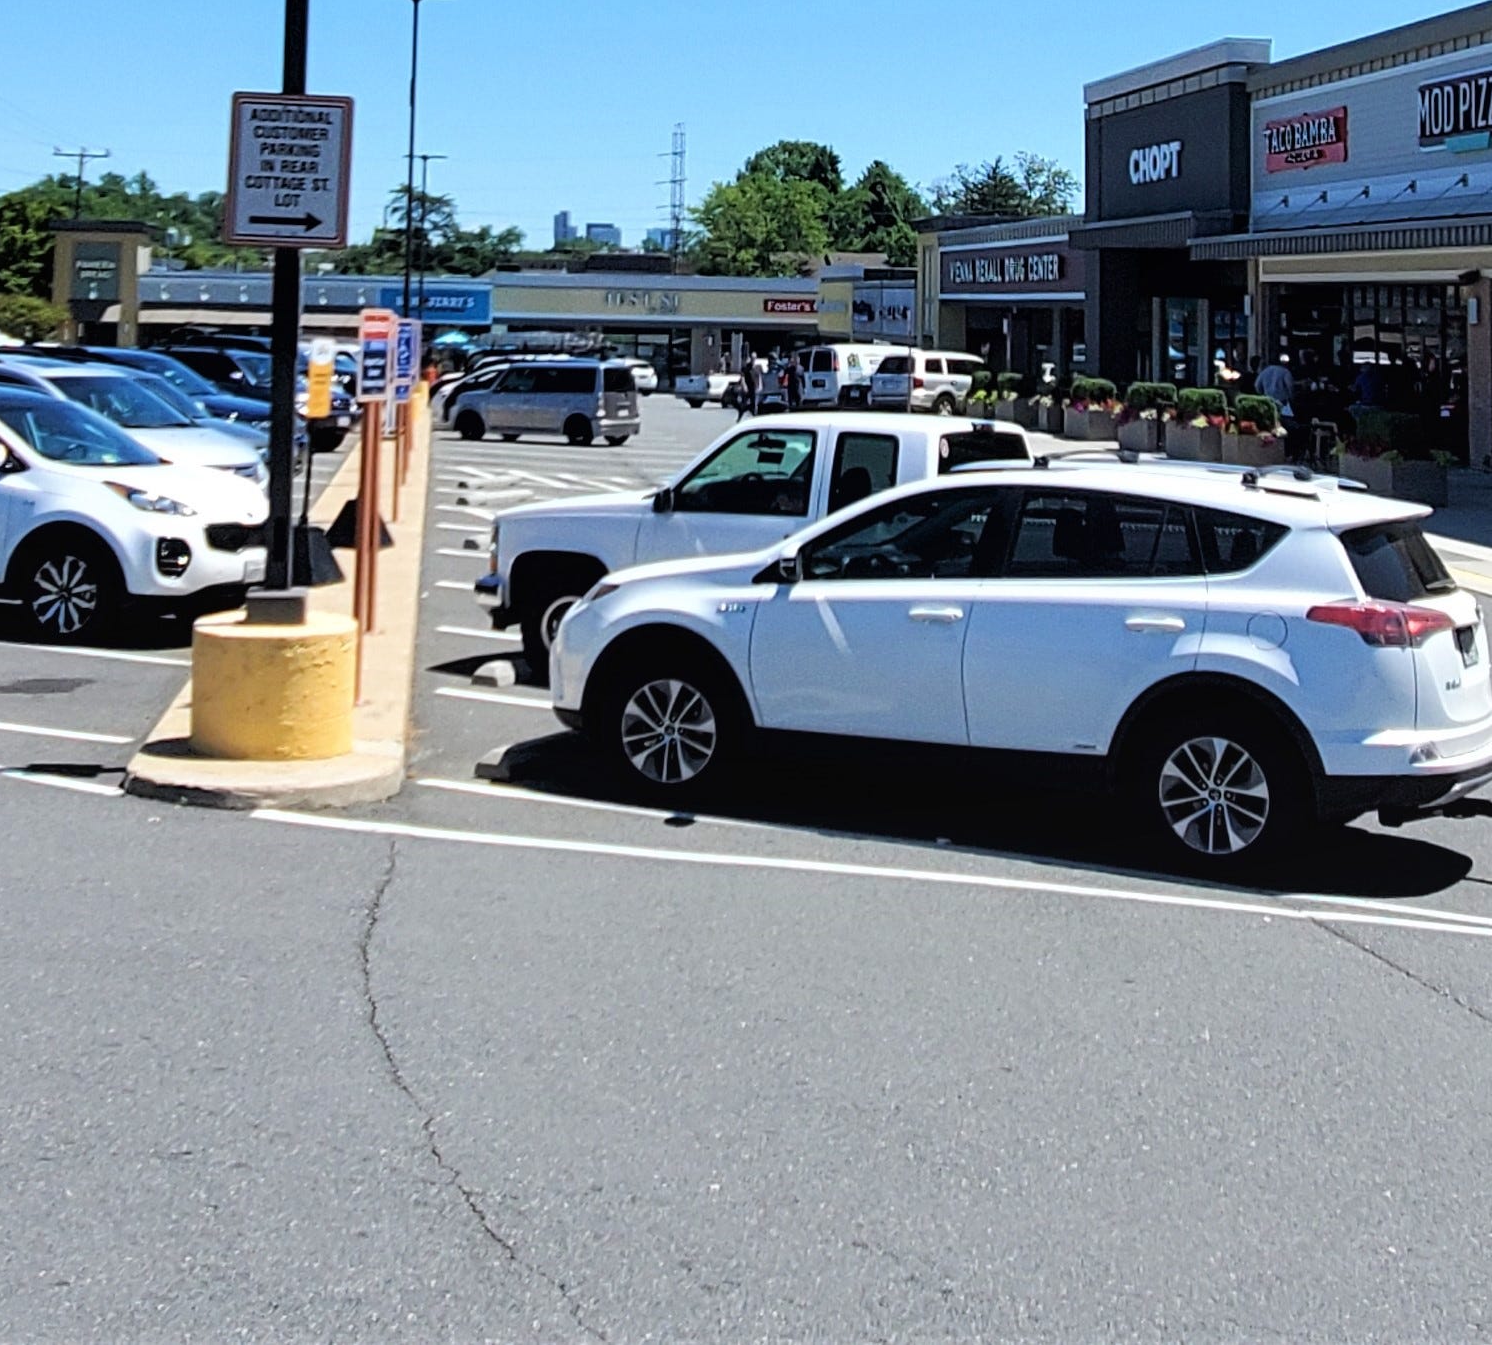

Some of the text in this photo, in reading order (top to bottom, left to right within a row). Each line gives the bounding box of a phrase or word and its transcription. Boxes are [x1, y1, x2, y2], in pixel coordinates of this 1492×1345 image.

[250, 108, 333, 125] ADDITIONAL
[1418, 85, 1455, 137] MOD
[253, 125, 330, 141] CUSTOMER
[1263, 116, 1337, 154] TACO BAMBA
[260, 142, 321, 158] PARKING
[260, 160, 319, 174] IN REAR
[1129, 140, 1182, 185] CHOPT
[245, 175, 307, 192] COTTAGE
[274, 193, 301, 208] LOT
[1028, 253, 1059, 282] CENTER
[767, 300, 811, 312] Foster's
